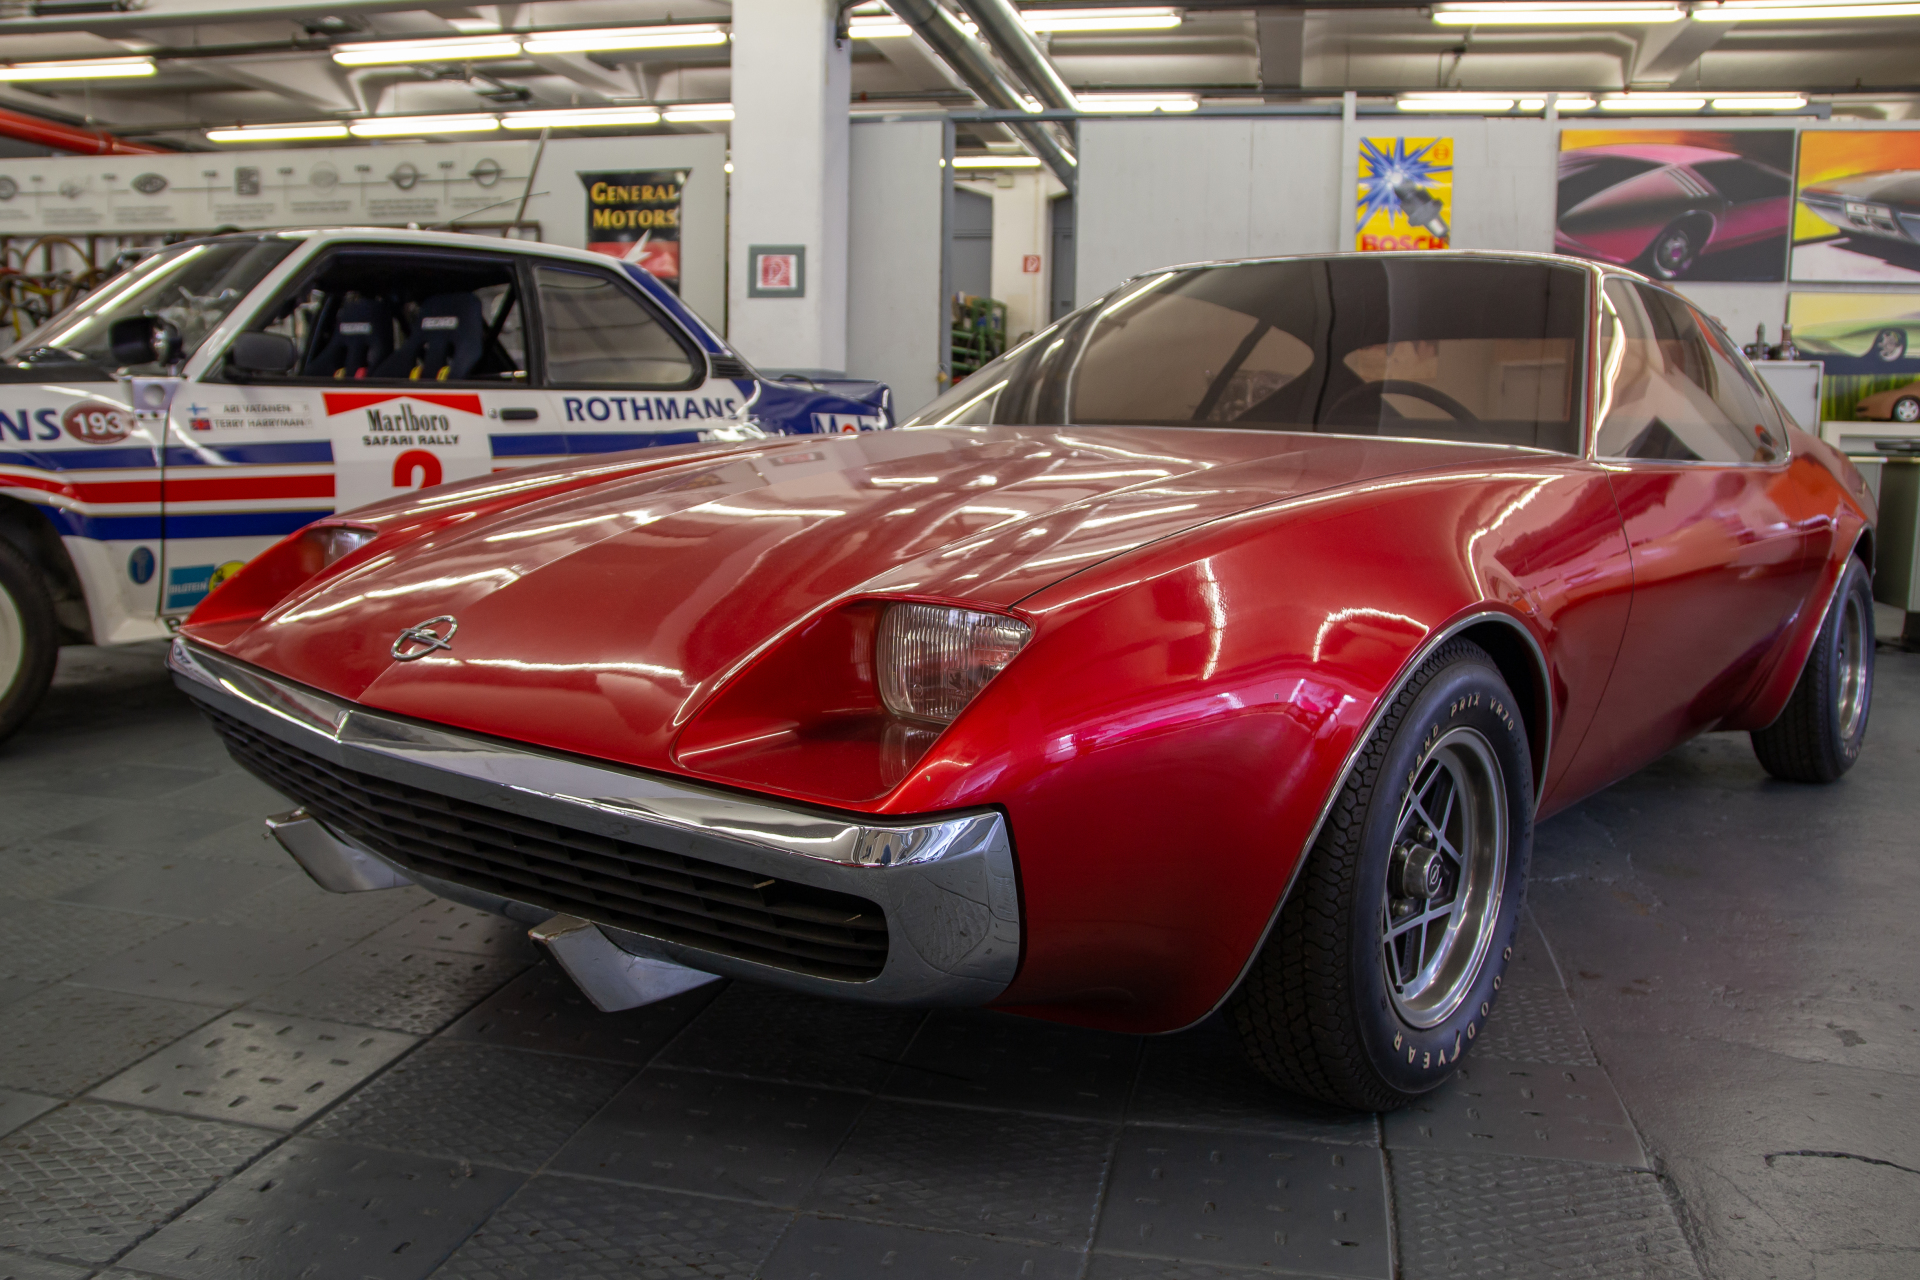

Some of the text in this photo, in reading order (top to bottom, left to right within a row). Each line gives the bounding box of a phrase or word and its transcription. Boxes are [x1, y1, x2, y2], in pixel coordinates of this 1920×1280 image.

[590, 182, 677, 204] GENERAL
[593, 208, 677, 229] MOTORS
[1362, 234, 1444, 251] BOSCH
[223, 404, 291, 413] ARI VATANEN
[366, 403, 450, 431] Marlboro
[563, 396, 738, 421] ROTHMANS
[215, 418, 305, 428] TERRY HARRYMAN
[362, 434, 460, 446] SAFARI RALLY
[1450, 693, 1481, 718] PRIX
[1490, 696, 1515, 732] VR70
[1393, 946, 1512, 1070] GOODYEAR
